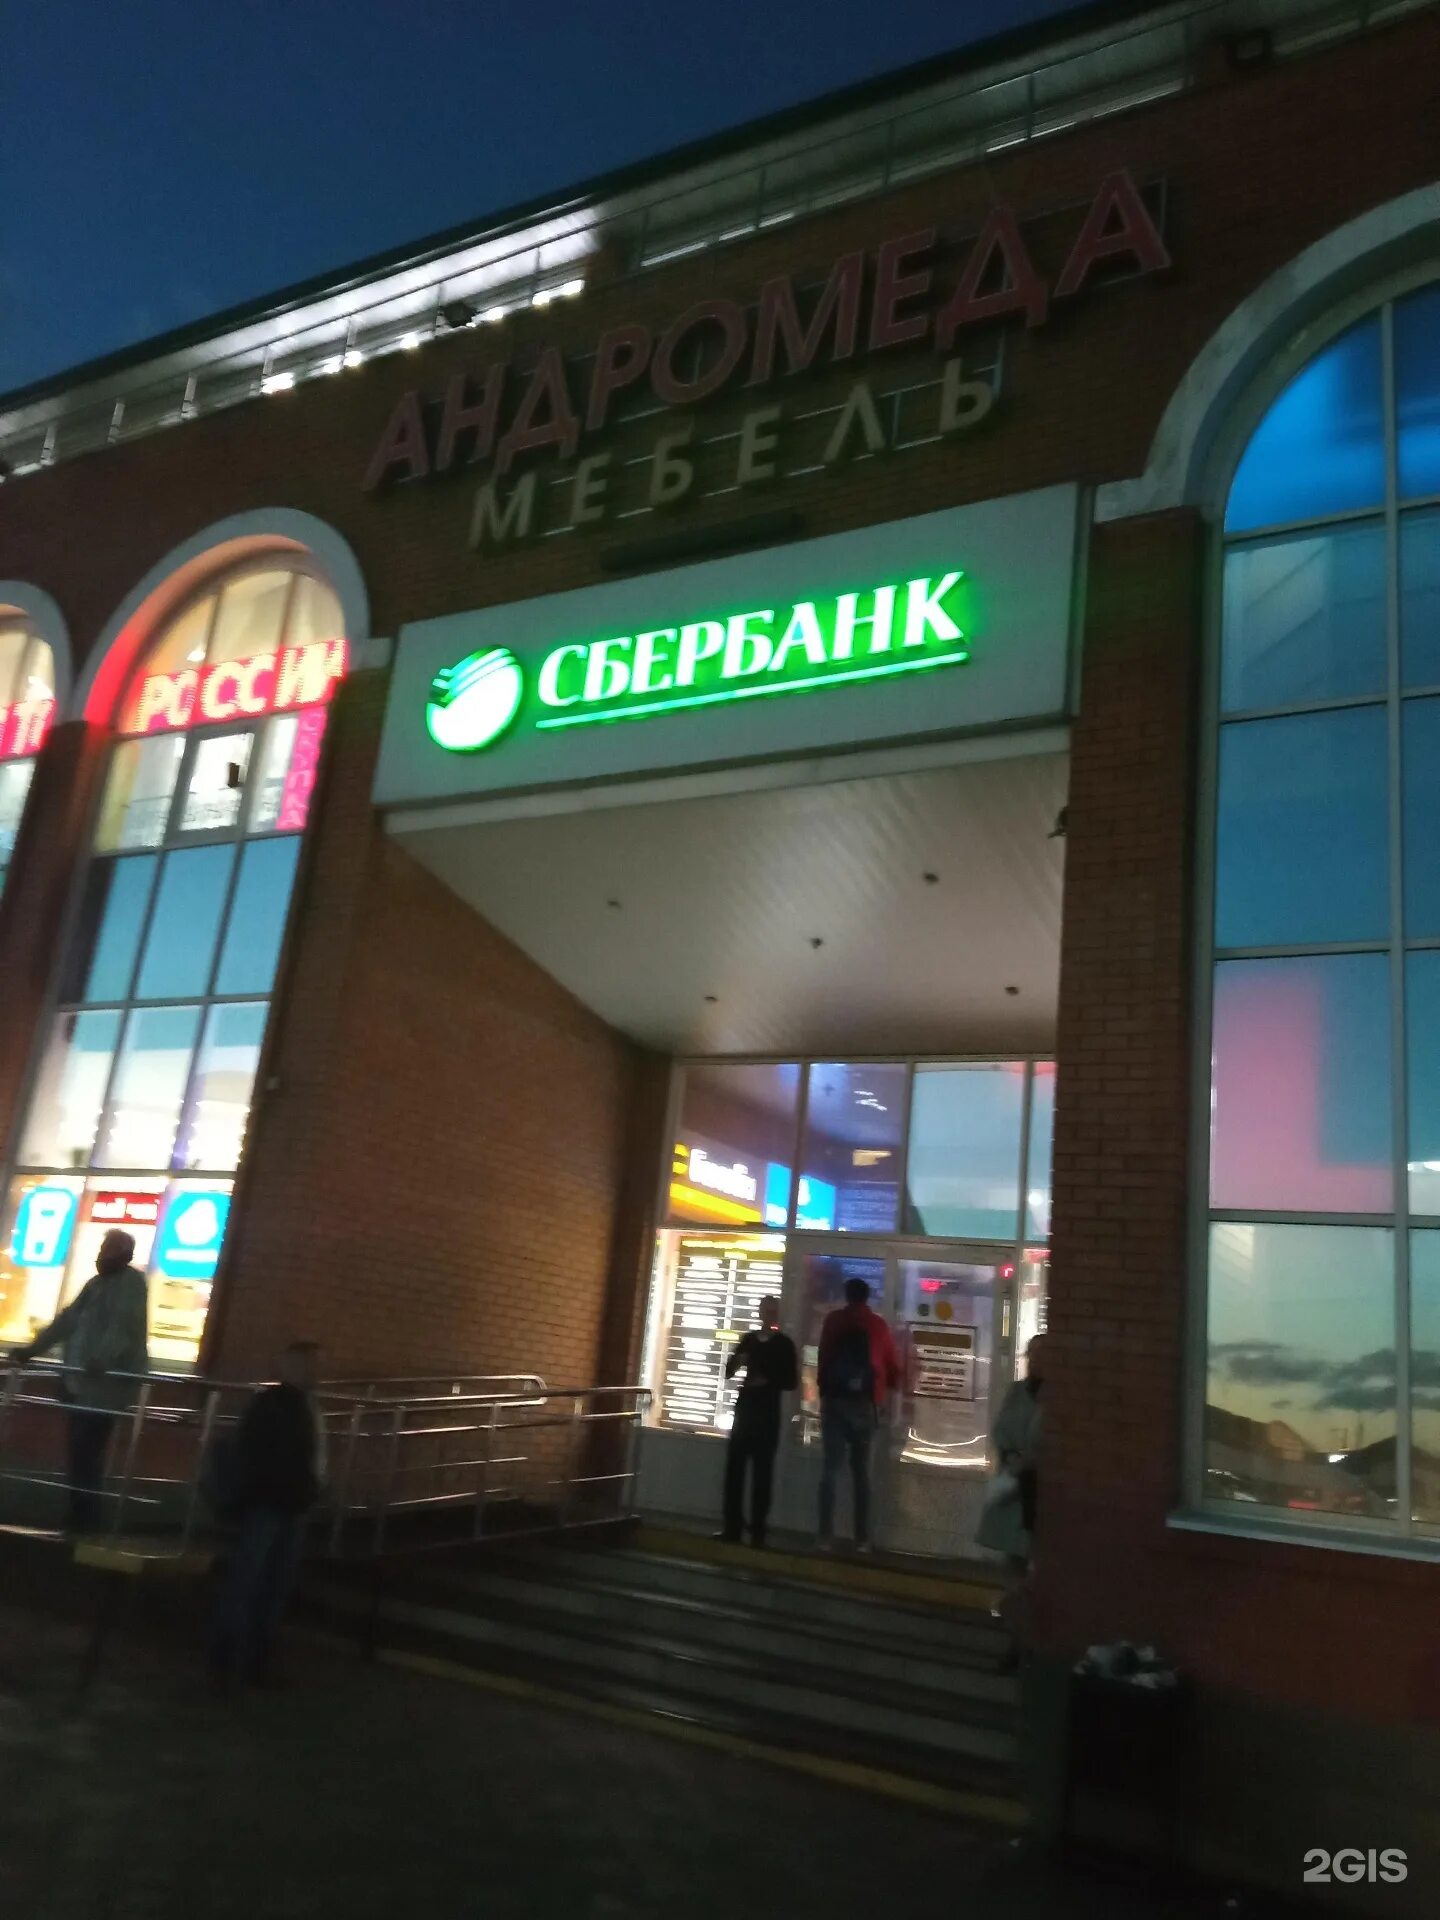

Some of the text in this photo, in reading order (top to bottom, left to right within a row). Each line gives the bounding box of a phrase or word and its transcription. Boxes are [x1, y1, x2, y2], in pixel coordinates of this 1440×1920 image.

[361, 168, 1173, 492] АНДРОМЕДА
[468, 357, 994, 549] МЕБЕЛЬ
[536, 571, 965, 707] СБЕРБАНК
